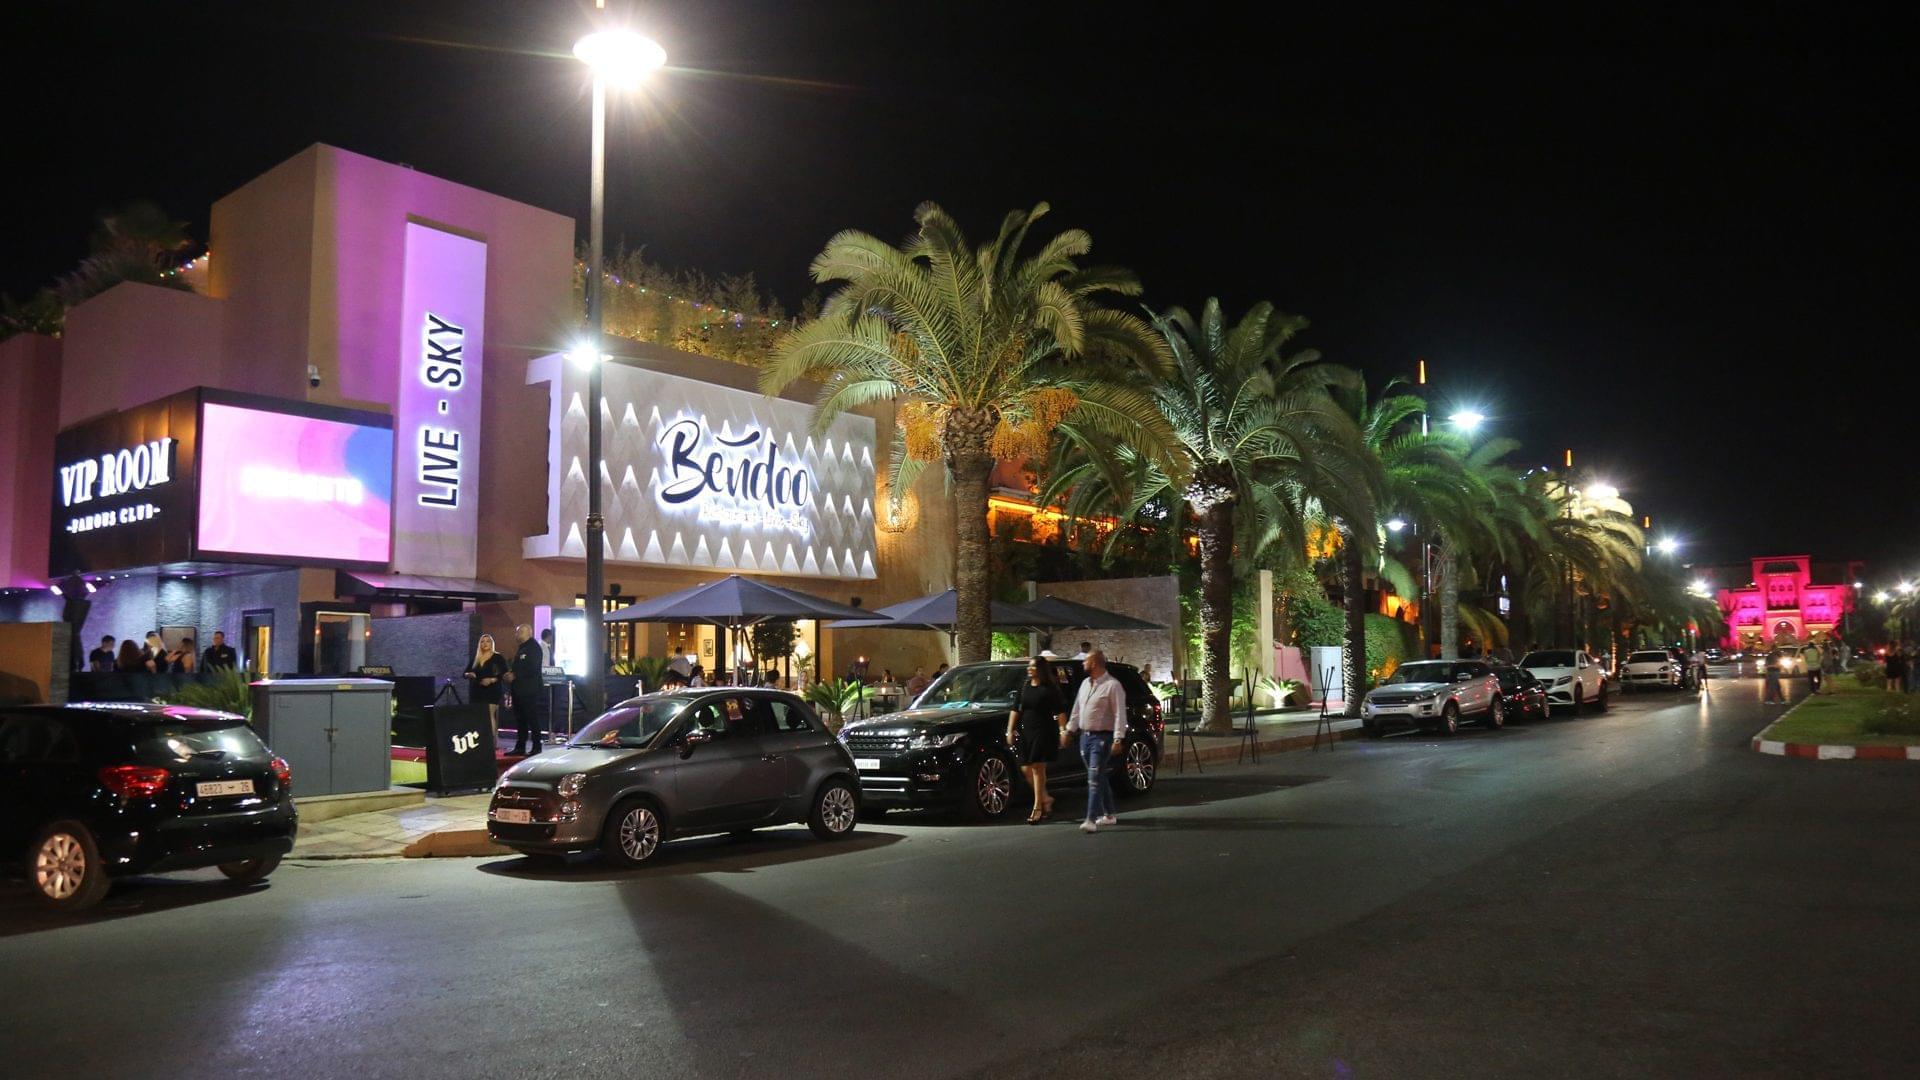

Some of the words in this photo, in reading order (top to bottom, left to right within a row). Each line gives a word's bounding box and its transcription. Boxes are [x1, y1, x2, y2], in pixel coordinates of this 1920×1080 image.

[427, 314, 463, 387] SKY
[60, 459, 98, 507] VIP
[99, 438, 173, 497] ROOM
[422, 430, 459, 506] LIVE
